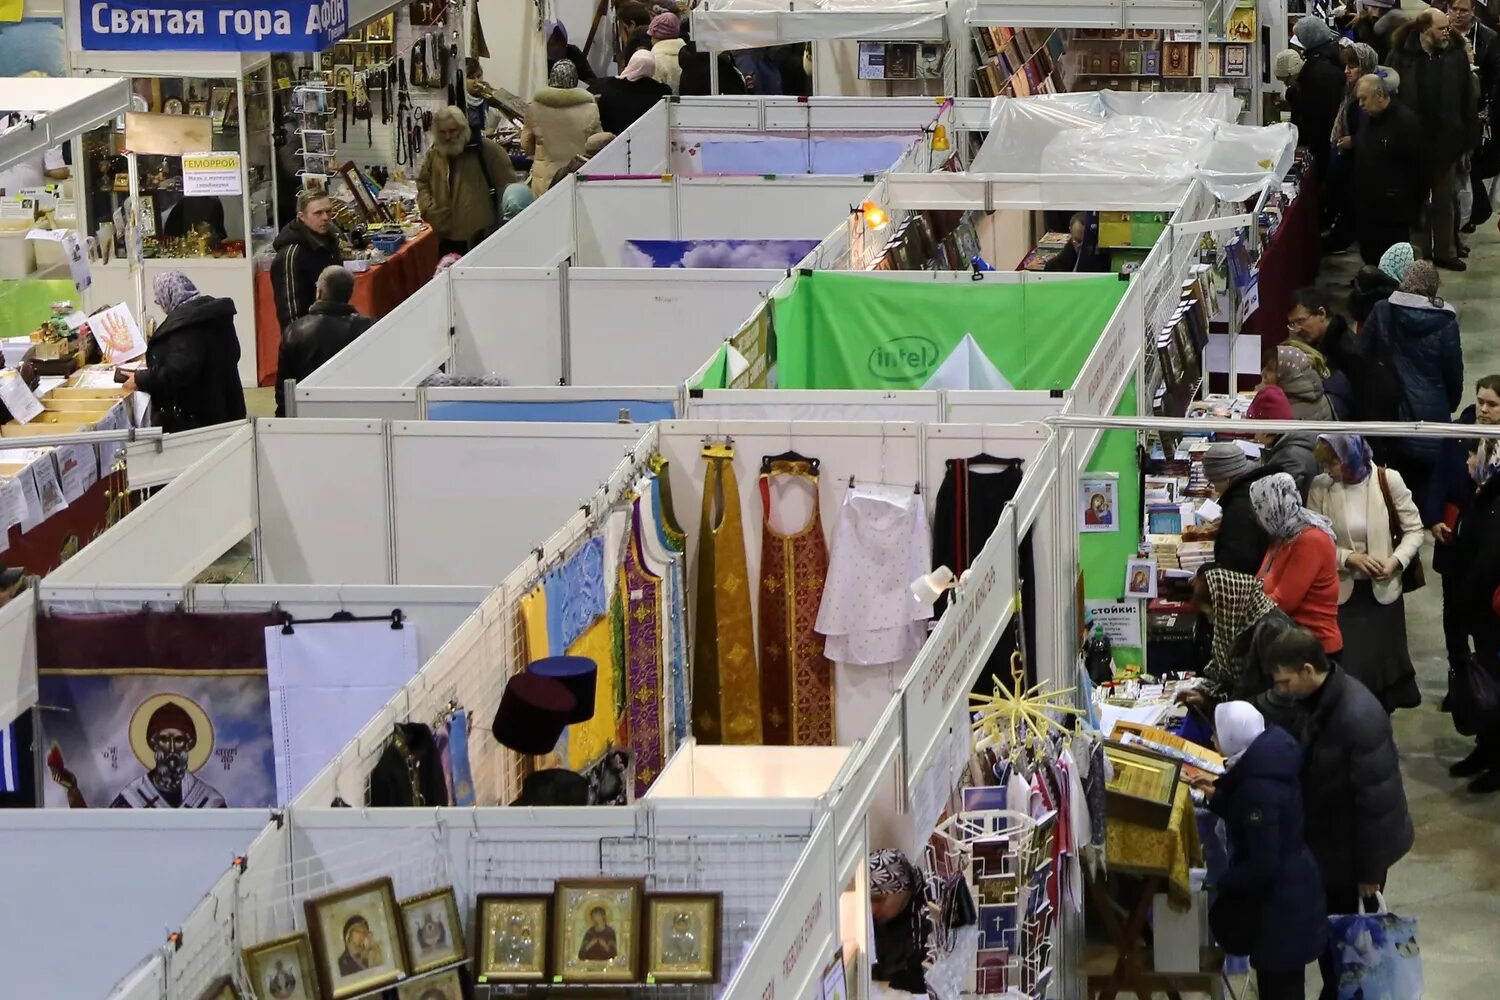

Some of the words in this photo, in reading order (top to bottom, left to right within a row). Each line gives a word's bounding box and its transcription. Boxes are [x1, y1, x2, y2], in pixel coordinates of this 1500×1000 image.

[91, 2, 204, 34] Святая
[218, 8, 291, 40] гора
[876, 345, 930, 368] intel
[1091, 605, 1136, 615] стойки:
